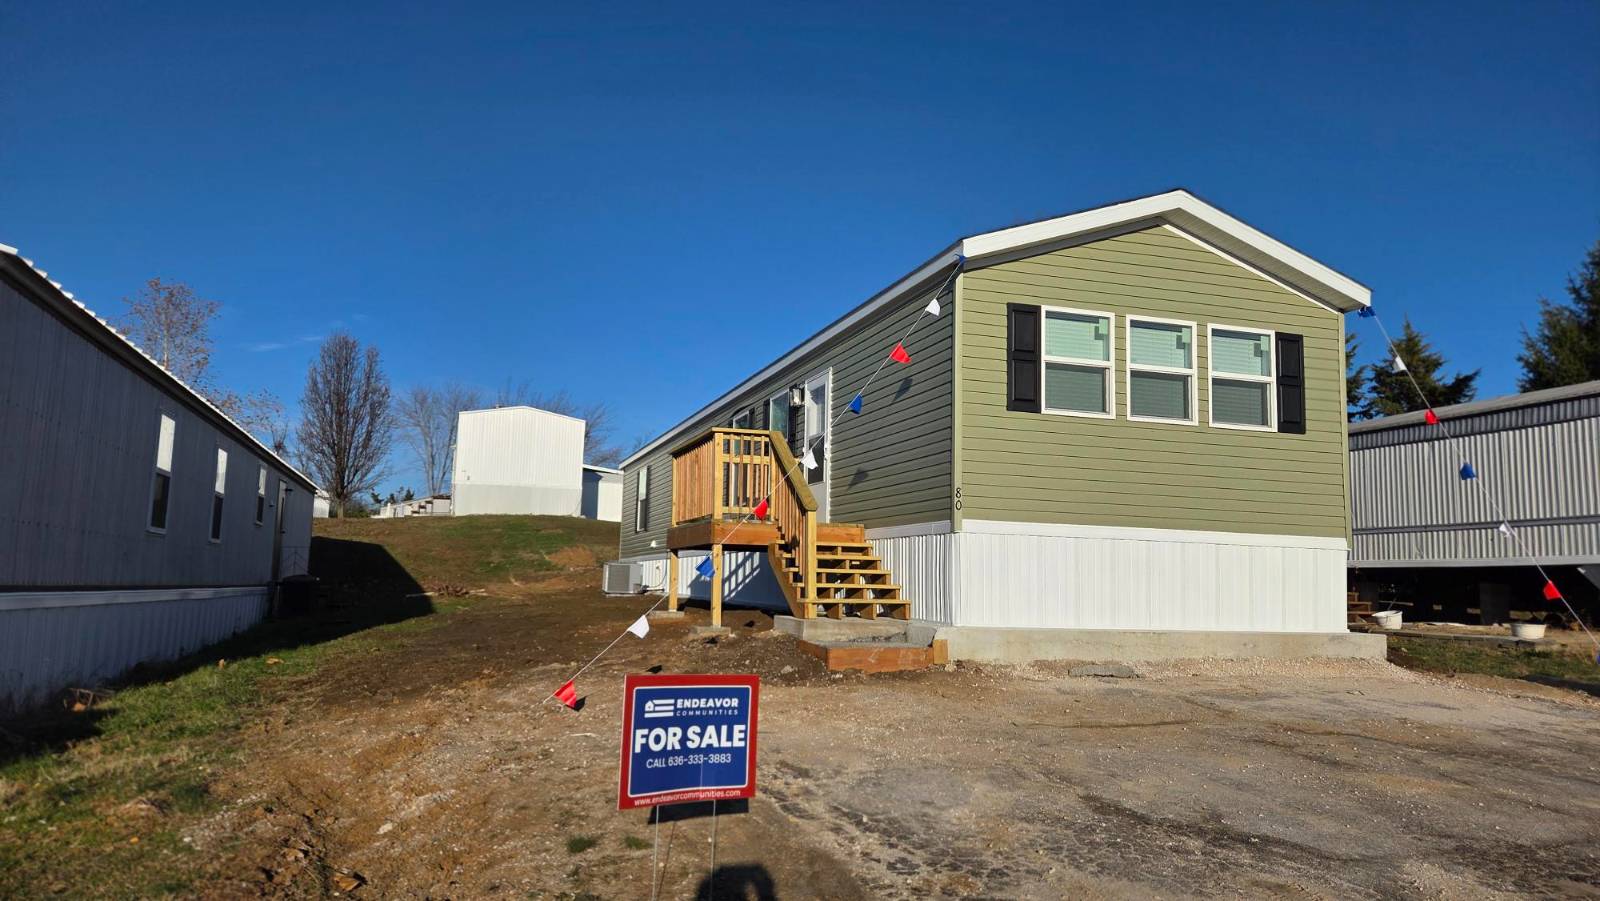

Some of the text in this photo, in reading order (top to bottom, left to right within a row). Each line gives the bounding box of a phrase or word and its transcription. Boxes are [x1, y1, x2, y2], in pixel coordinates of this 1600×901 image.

[676, 698, 739, 709] ENDEAVOR
[676, 709, 739, 717] COMMUNITIES
[634, 724, 746, 753] FOR SALE
[646, 753, 732, 769] CALL 636-333-3883
[634, 789, 741, 807] www.endeavorcommunities.com
